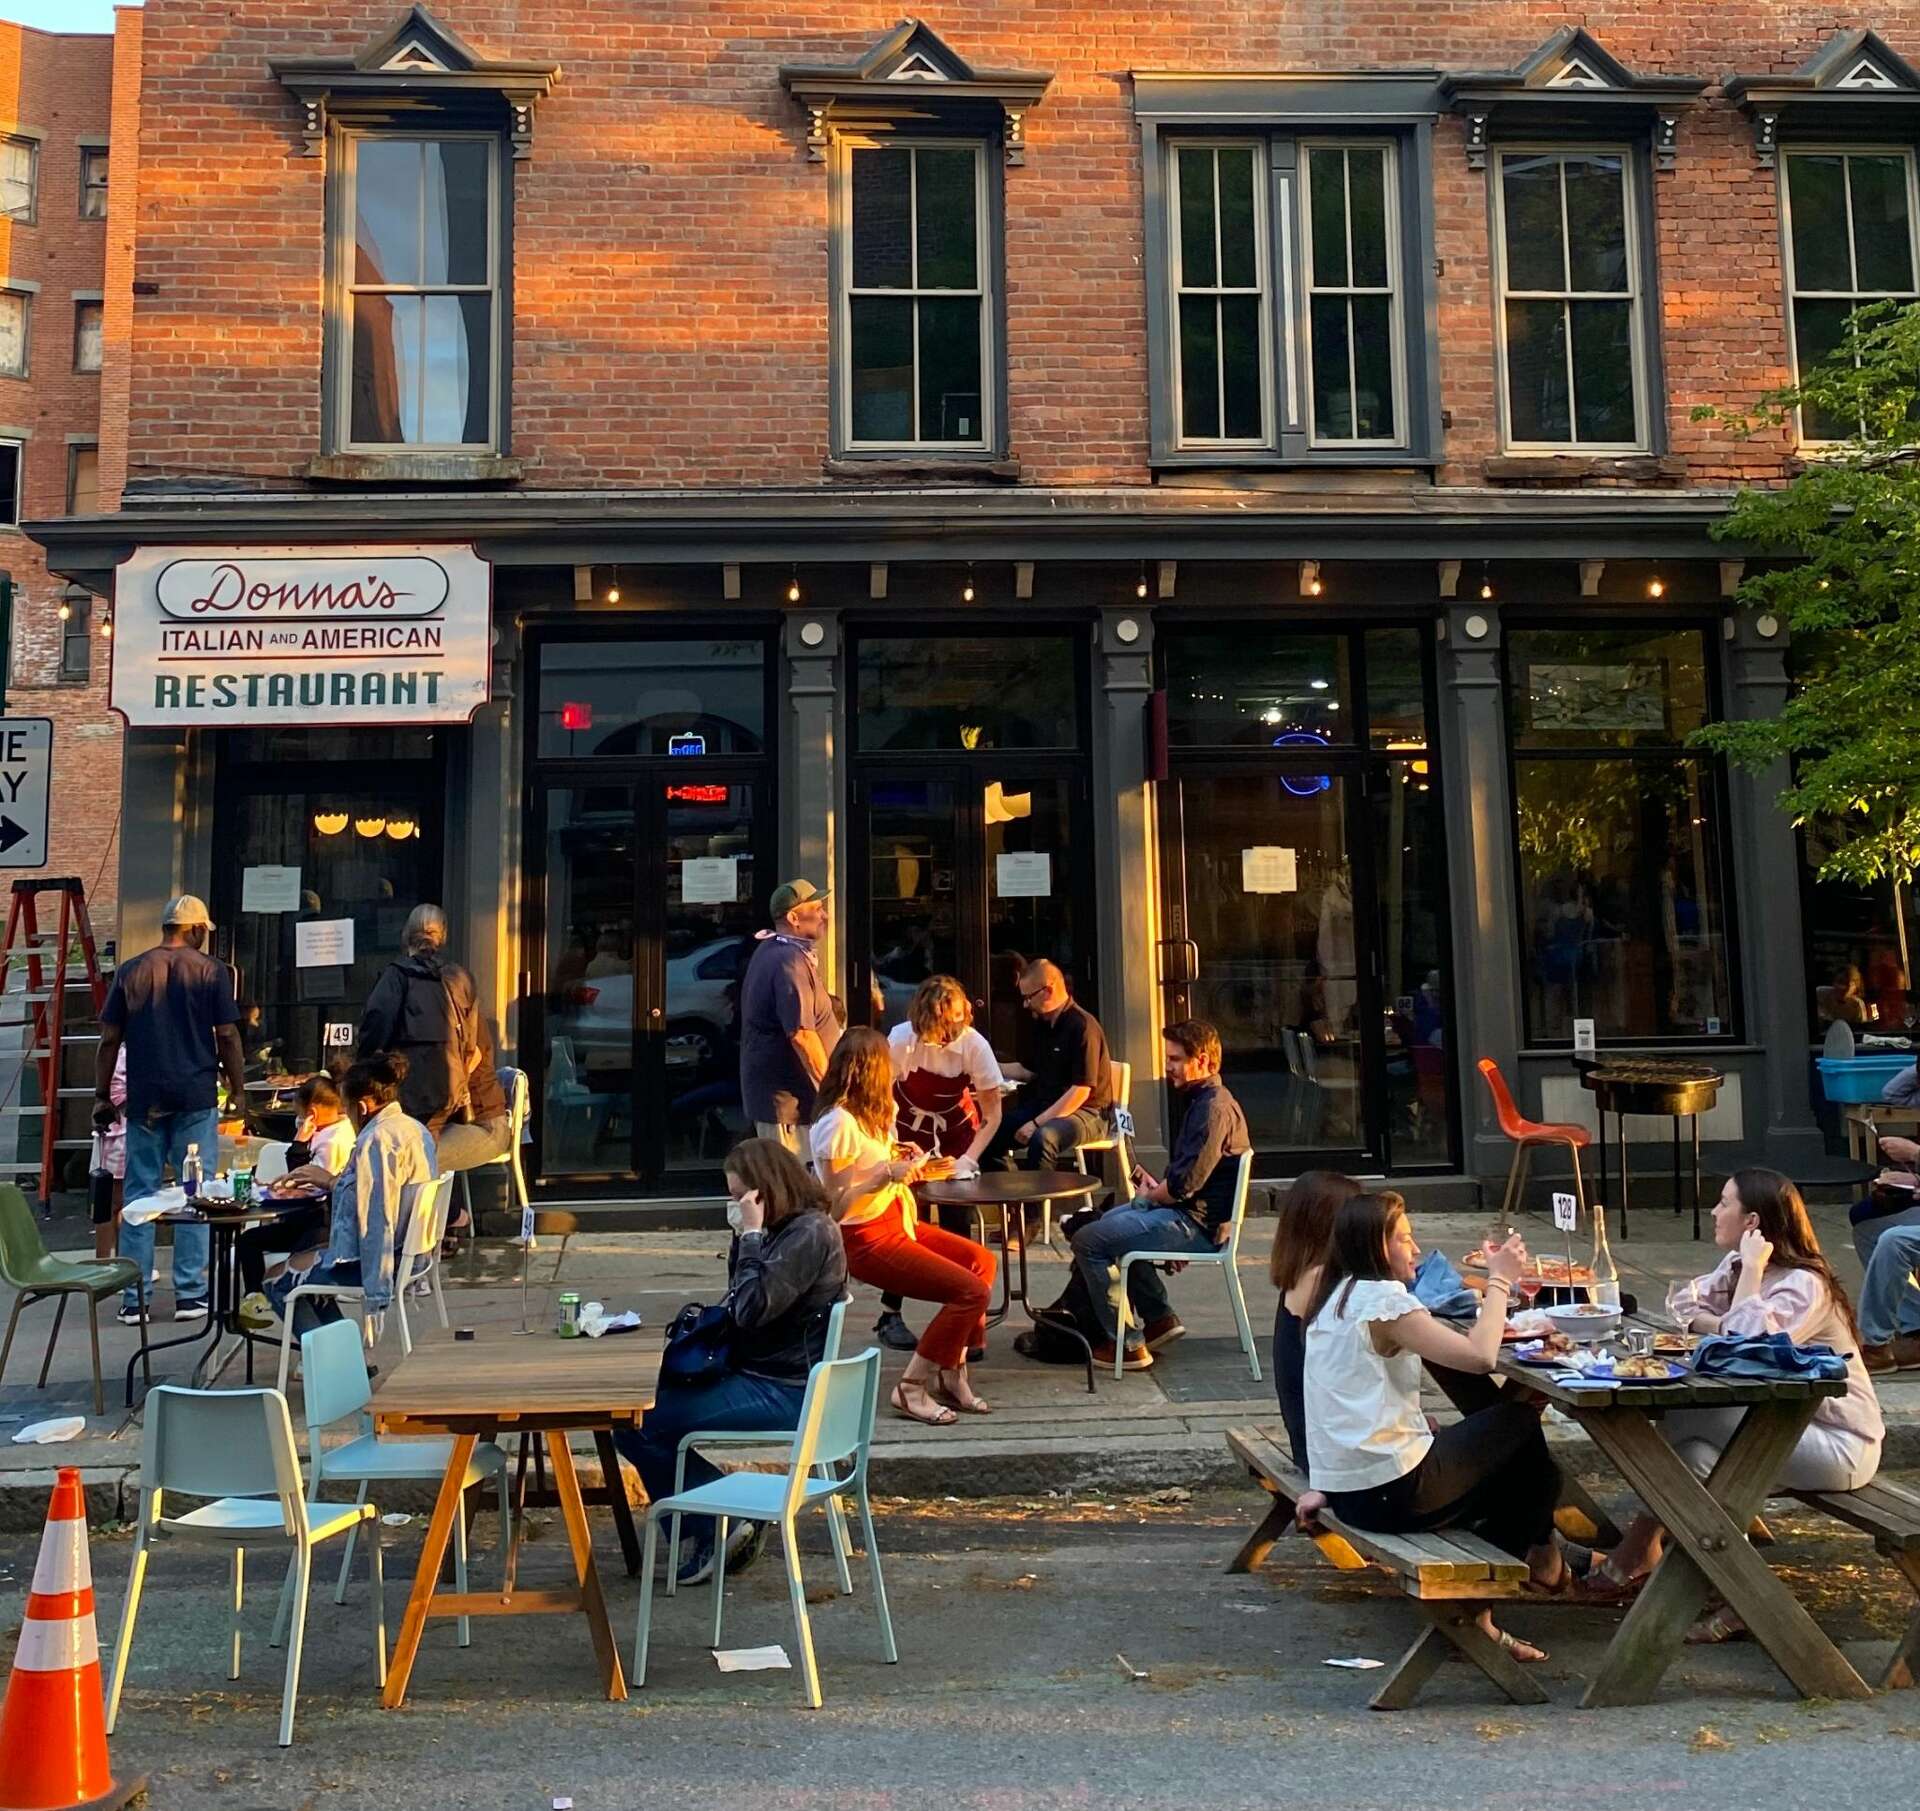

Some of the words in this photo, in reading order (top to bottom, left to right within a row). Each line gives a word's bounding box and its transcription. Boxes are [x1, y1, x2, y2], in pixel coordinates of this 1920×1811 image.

[190, 563, 415, 613] Donna's
[162, 629, 264, 651] ITALIAN
[269, 633, 298, 645] AND
[302, 627, 441, 650] AMERICAN
[154, 671, 444, 709] RESTAURANT
[0, 771, 28, 803] Y
[333, 1027, 350, 1041] 49
[1558, 1196, 1572, 1219] 128
